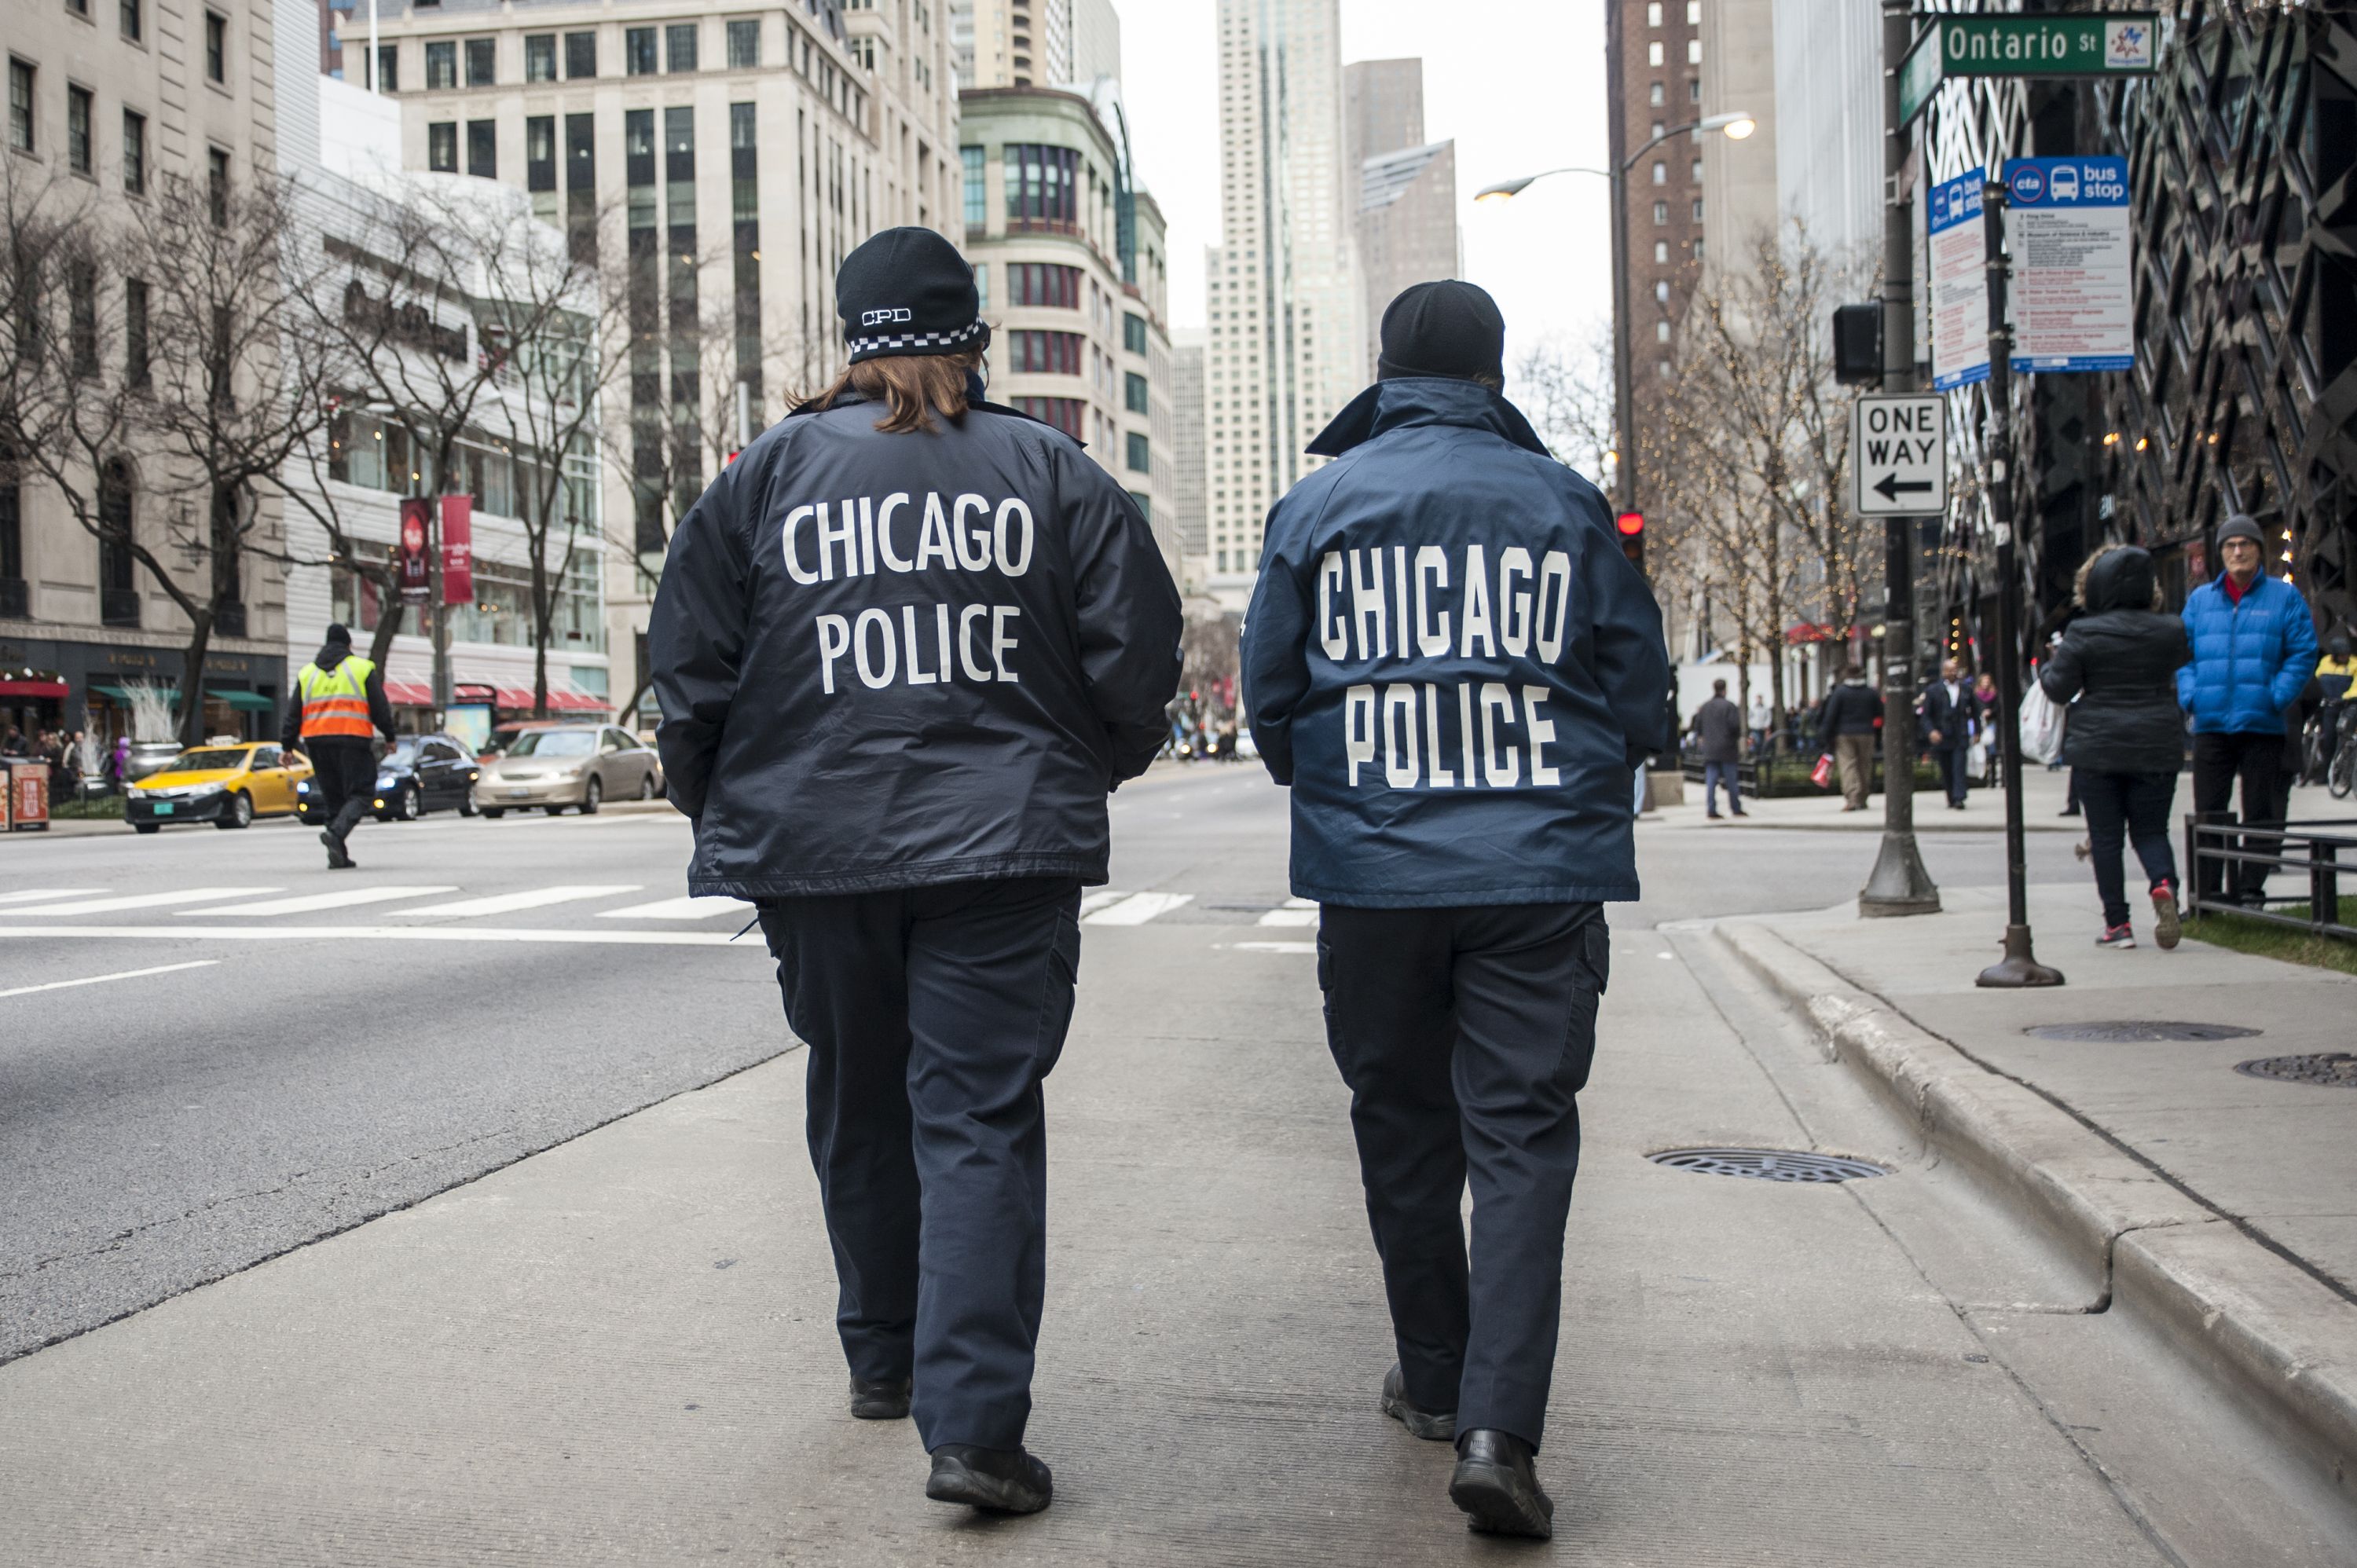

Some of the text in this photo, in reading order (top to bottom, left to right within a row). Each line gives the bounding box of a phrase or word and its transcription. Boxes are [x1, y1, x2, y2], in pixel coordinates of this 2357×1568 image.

[1948, 26, 2067, 60] Ontario
[2079, 33, 2096, 52] St
[2016, 177, 2040, 190] cta
[2083, 164, 2117, 182] bus
[2084, 184, 2124, 201] stop
[862, 308, 911, 326] CPD
[1869, 406, 1934, 433] ONE
[1868, 438, 1935, 466] WAY
[783, 492, 1034, 584] CHICAGO
[1320, 544, 1571, 664] CHICAGO
[816, 603, 1021, 694] POLICE
[1345, 683, 1560, 788] POLICE
